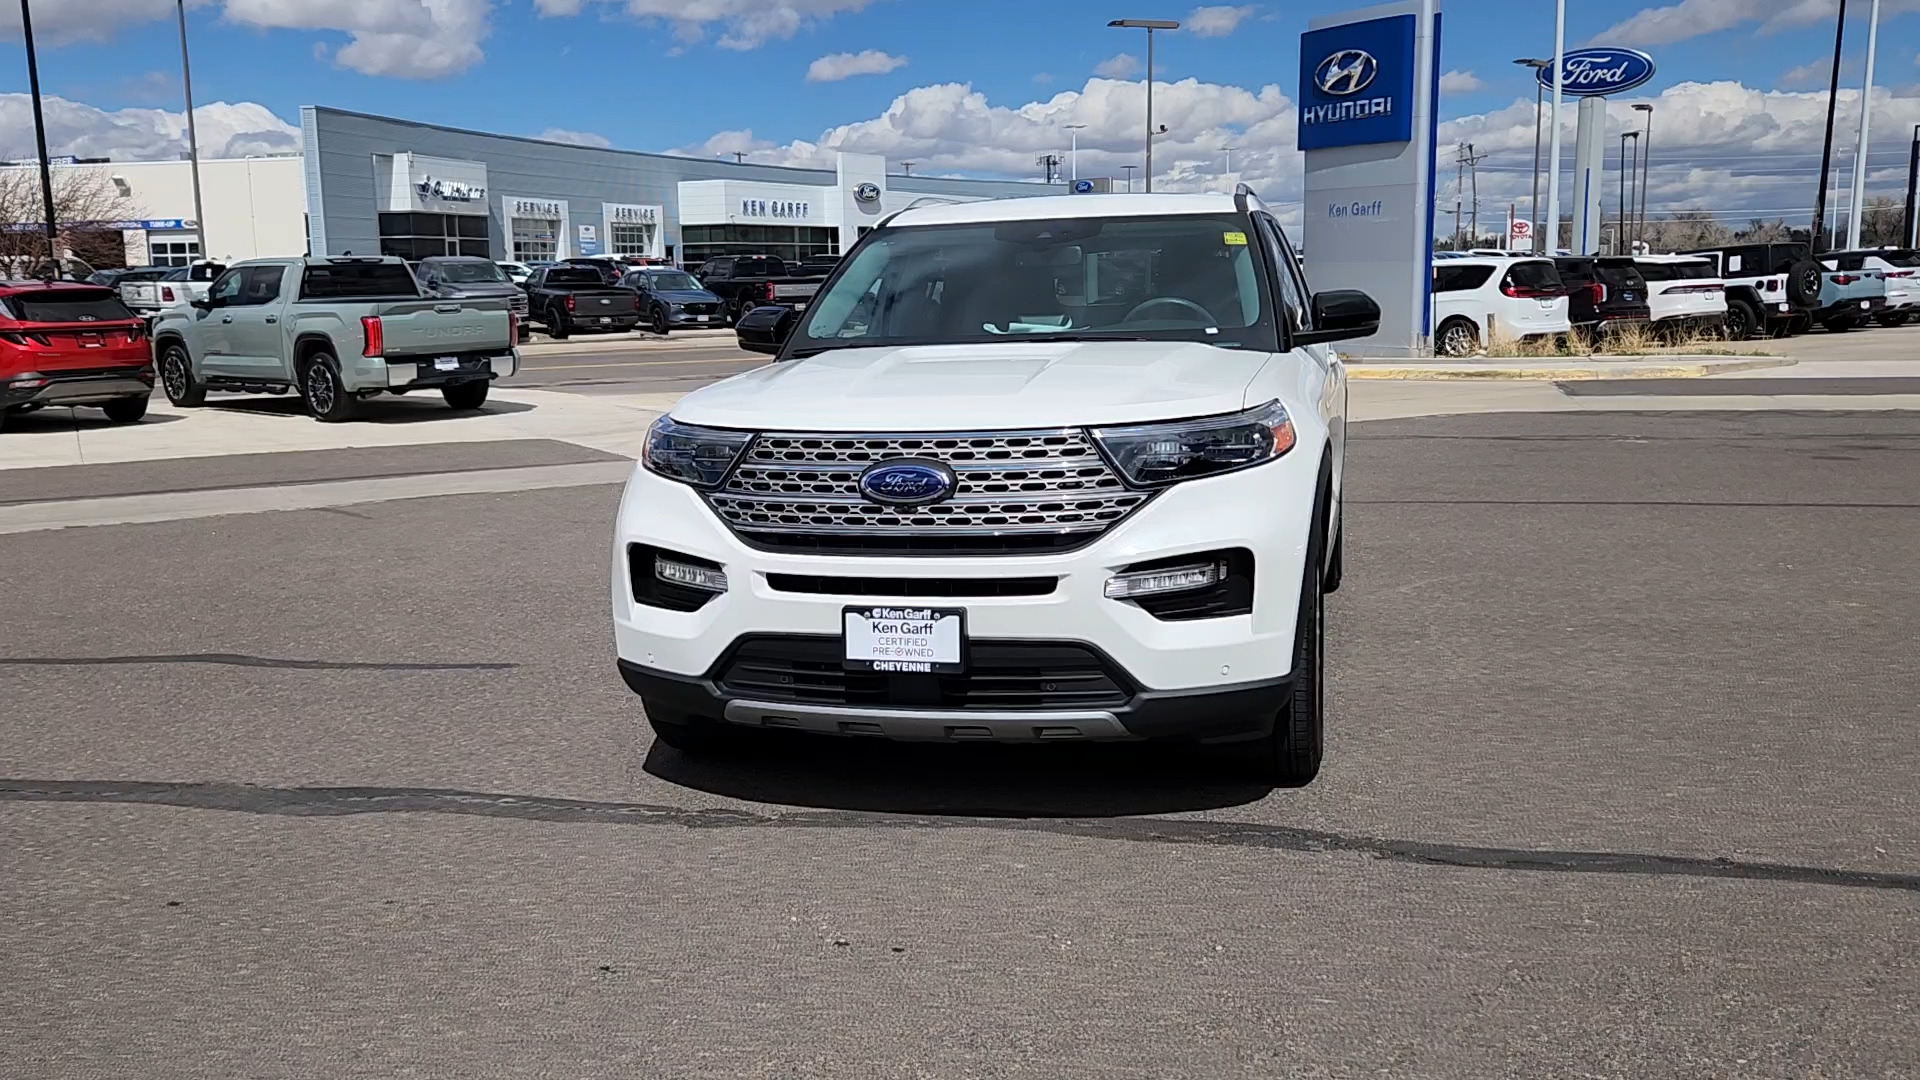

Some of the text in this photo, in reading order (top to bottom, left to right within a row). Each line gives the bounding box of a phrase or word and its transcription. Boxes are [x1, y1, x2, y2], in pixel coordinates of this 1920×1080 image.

[1561, 56, 1629, 85] Ford
[1303, 97, 1392, 125] HYUNDAI
[515, 201, 560, 214] SERVICE
[615, 207, 655, 219] SERVICE
[742, 200, 809, 215] KEN GARFF
[1328, 200, 1382, 218] Ken Garff
[411, 324, 488, 339] TUNDRA
[880, 472, 928, 493] Ford
[881, 608, 931, 620] Ken Garff
[872, 622, 933, 635] Ken Garff
[878, 637, 928, 647] CERTIFIED
[873, 661, 931, 672] CHEYENNE
